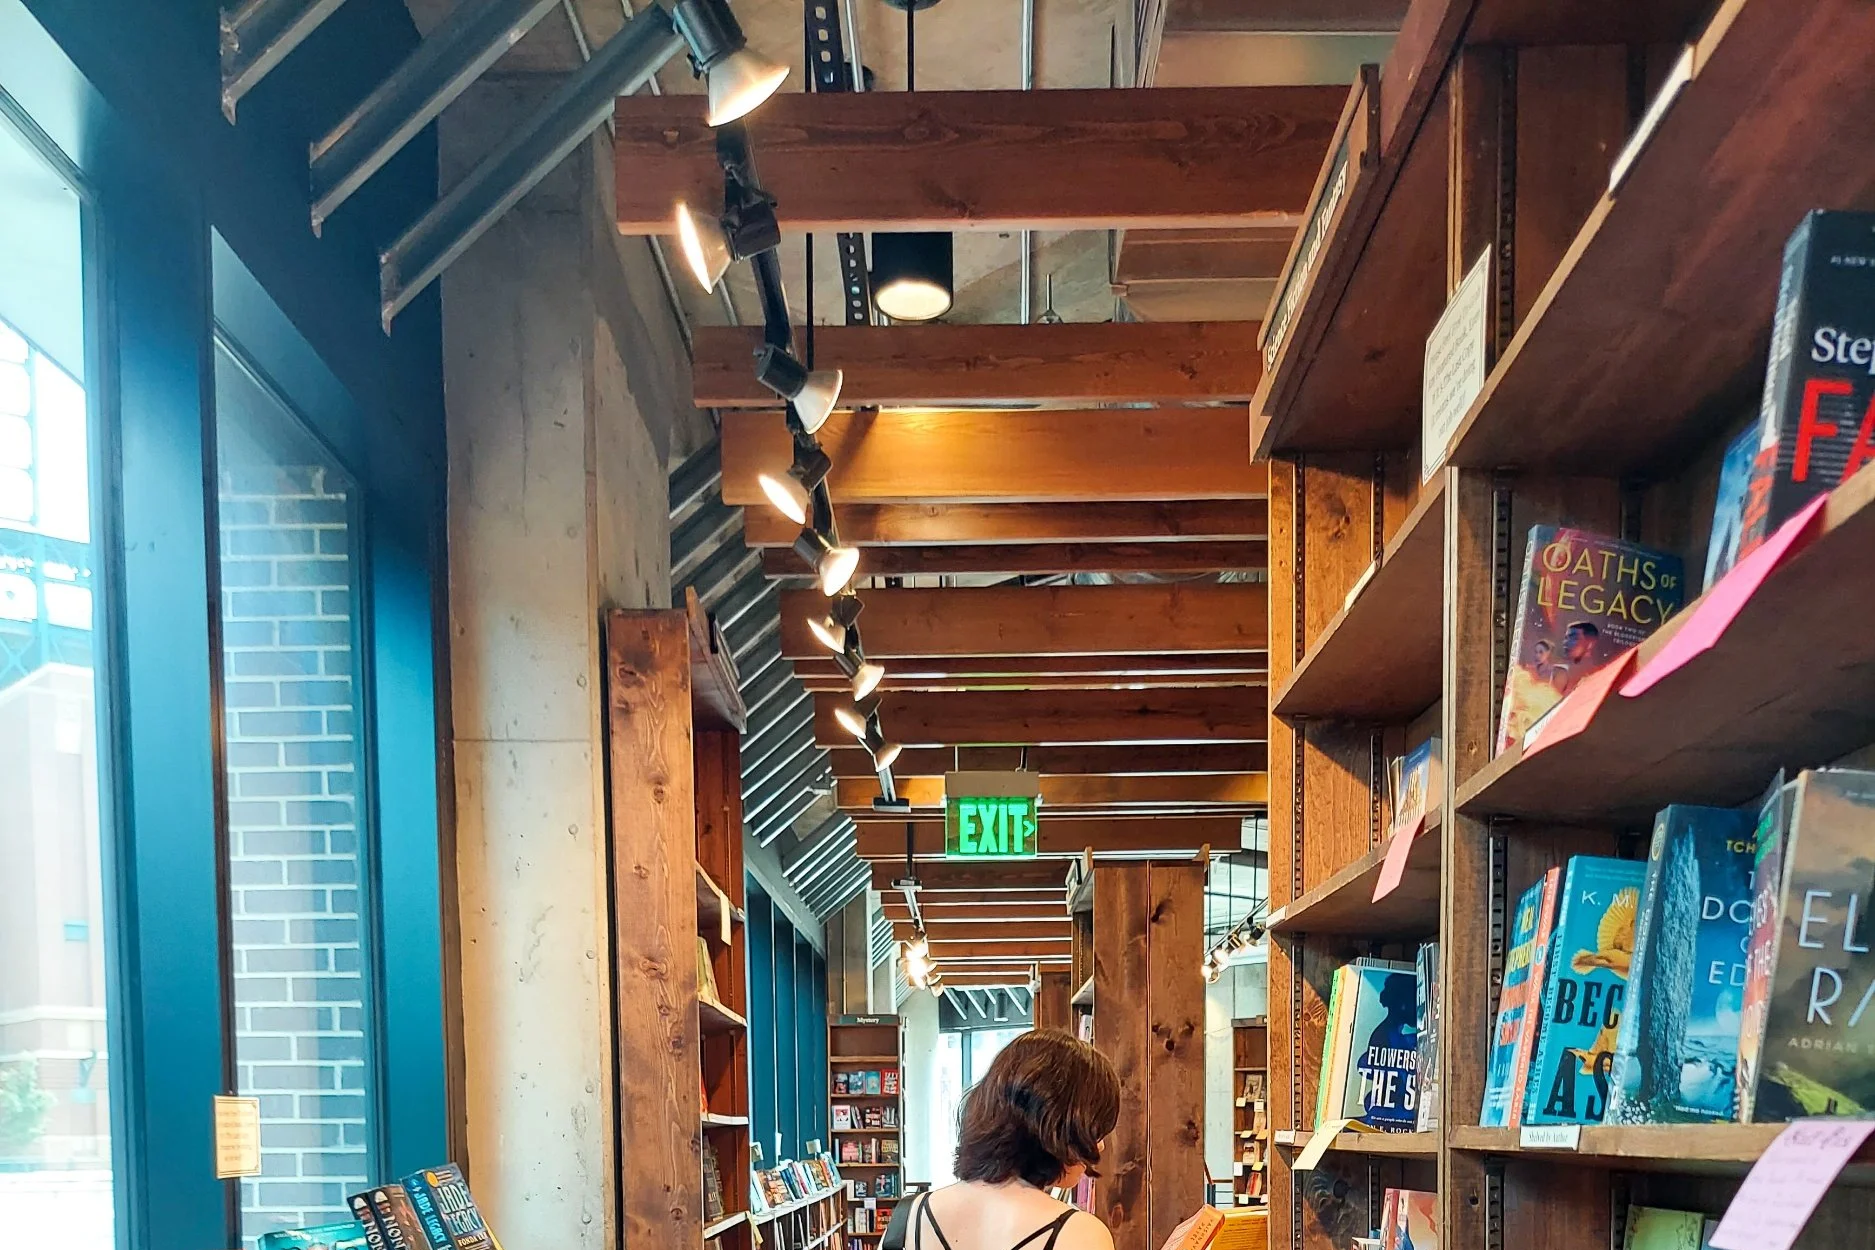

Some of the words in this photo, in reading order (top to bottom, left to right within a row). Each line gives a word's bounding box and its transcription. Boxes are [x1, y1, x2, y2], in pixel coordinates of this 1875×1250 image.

[1543, 543, 1657, 590] OATHS
[1661, 574, 1678, 590] OF
[1537, 577, 1675, 625] LEGACY
[960, 804, 1028, 853] EXIT
[1581, 890, 1602, 905] K.
[1612, 892, 1634, 908] M.
[1551, 933, 1563, 980] FIRST
[1542, 986, 1554, 1046] BECOME
[1553, 979, 1624, 1029] BEC
[1367, 1046, 1416, 1070] FLOWERS
[1787, 1036, 1857, 1054] ADRIAN
[1358, 1068, 1396, 1110] THE
[1543, 1047, 1612, 1121] AS
[416, 1191, 430, 1215] JADE
[425, 1214, 445, 1243] LEGACY
[437, 1182, 473, 1214] JADE
[443, 1208, 484, 1236] LEGACY
[458, 1236, 479, 1247] FONDA
